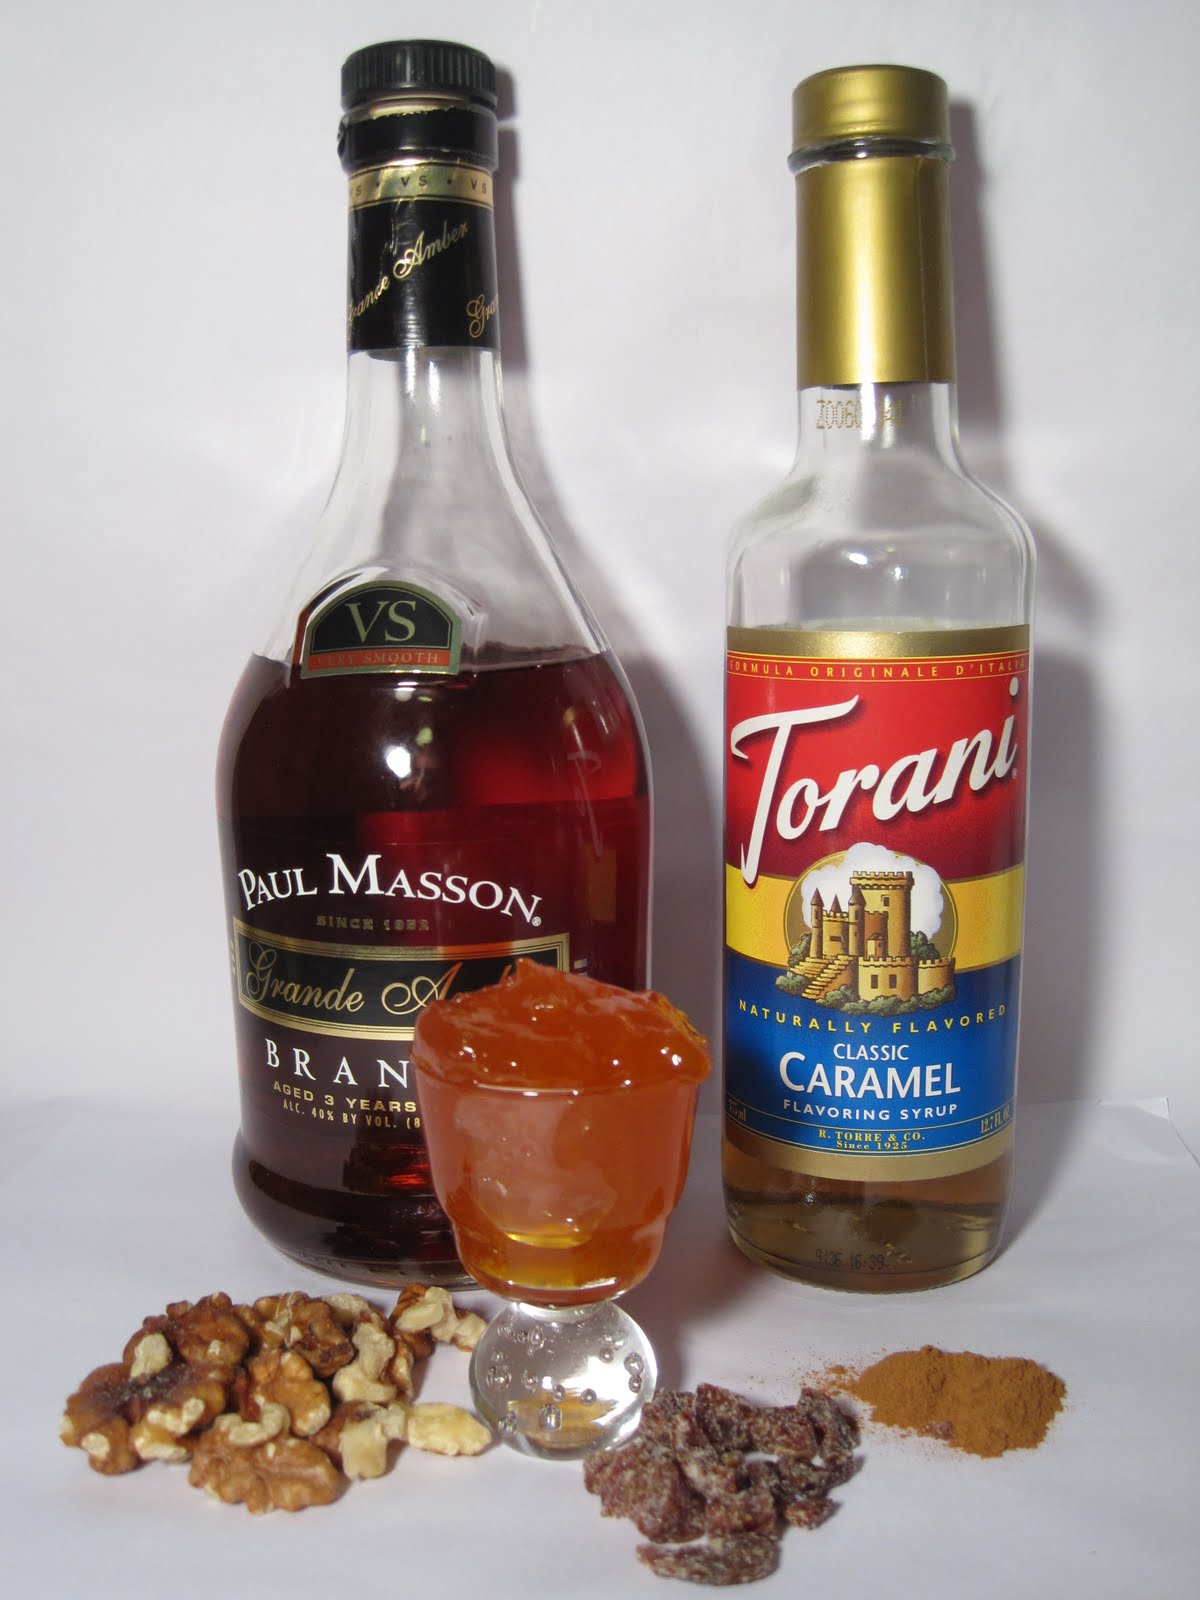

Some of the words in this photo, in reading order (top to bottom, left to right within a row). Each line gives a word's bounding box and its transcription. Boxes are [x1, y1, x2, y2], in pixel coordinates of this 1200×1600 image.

[345, 600, 417, 643] VS
[363, 652, 439, 665] SMOOTH
[730, 660, 794, 677] FORMULA
[810, 665, 939, 679] ORIGINALE
[731, 676, 1019, 884] Torani
[238, 867, 318, 911] PAUL
[246, 941, 366, 1013] Grande
[738, 999, 872, 1034] NATURALLY
[892, 1004, 1007, 1034] FLAVORED
[833, 1043, 909, 1061] CLASSIC
[779, 1051, 961, 1099] CARAMEL
[273, 1080, 314, 1102] AGED
[324, 1094, 335, 1106] 3
[345, 1097, 417, 1113] YEARS
[783, 1099, 890, 1121] FLAVORING
[900, 1103, 958, 1120] SYRUP
[283, 1099, 305, 1115] ALC.
[311, 1107, 334, 1121] 40%
[342, 1112, 357, 1125] BY
[365, 1114, 398, 1128] VOL.
[835, 1131, 882, 1142] TORRE
[888, 1133, 897, 1142] &
[903, 1131, 925, 1141] CO.
[836, 1140, 870, 1150] Since
[877, 1141, 908, 1150] 1925
